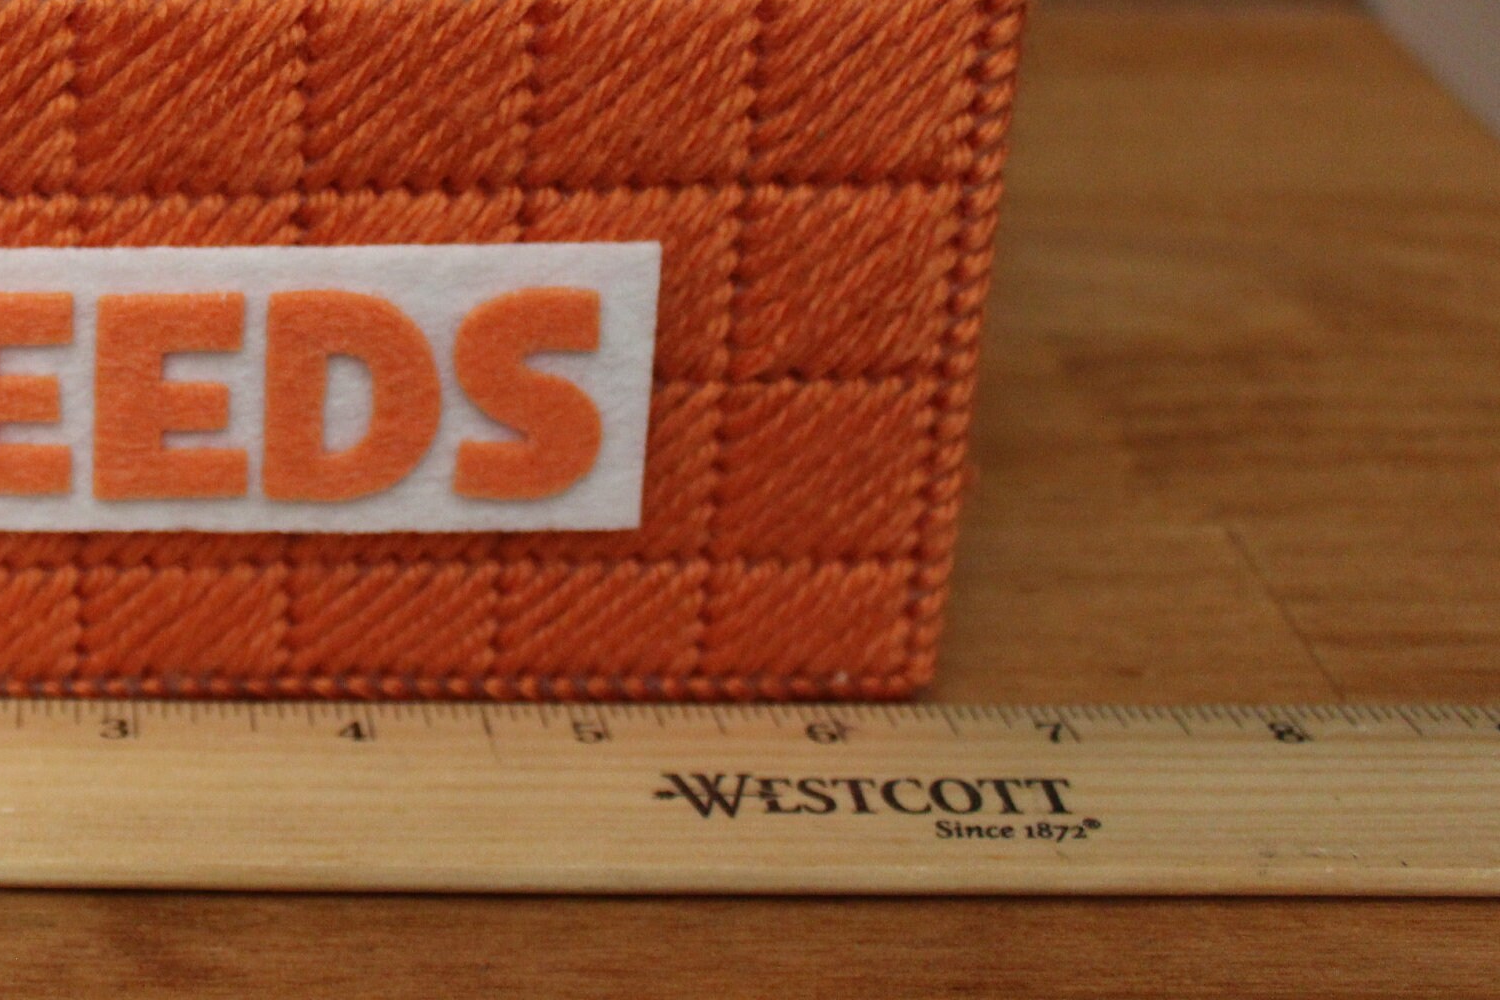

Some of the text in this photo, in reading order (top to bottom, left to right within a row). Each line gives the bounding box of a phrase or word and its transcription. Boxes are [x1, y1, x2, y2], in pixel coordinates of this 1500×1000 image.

[100, 717, 130, 740] 3
[337, 720, 367, 743] 4
[572, 720, 604, 743] 5
[805, 720, 840, 744] 6
[1035, 722, 1062, 743] 7
[1267, 722, 1305, 743] 8
[656, 772, 1073, 820] WESTCOTT
[935, 819, 1015, 840] Since
